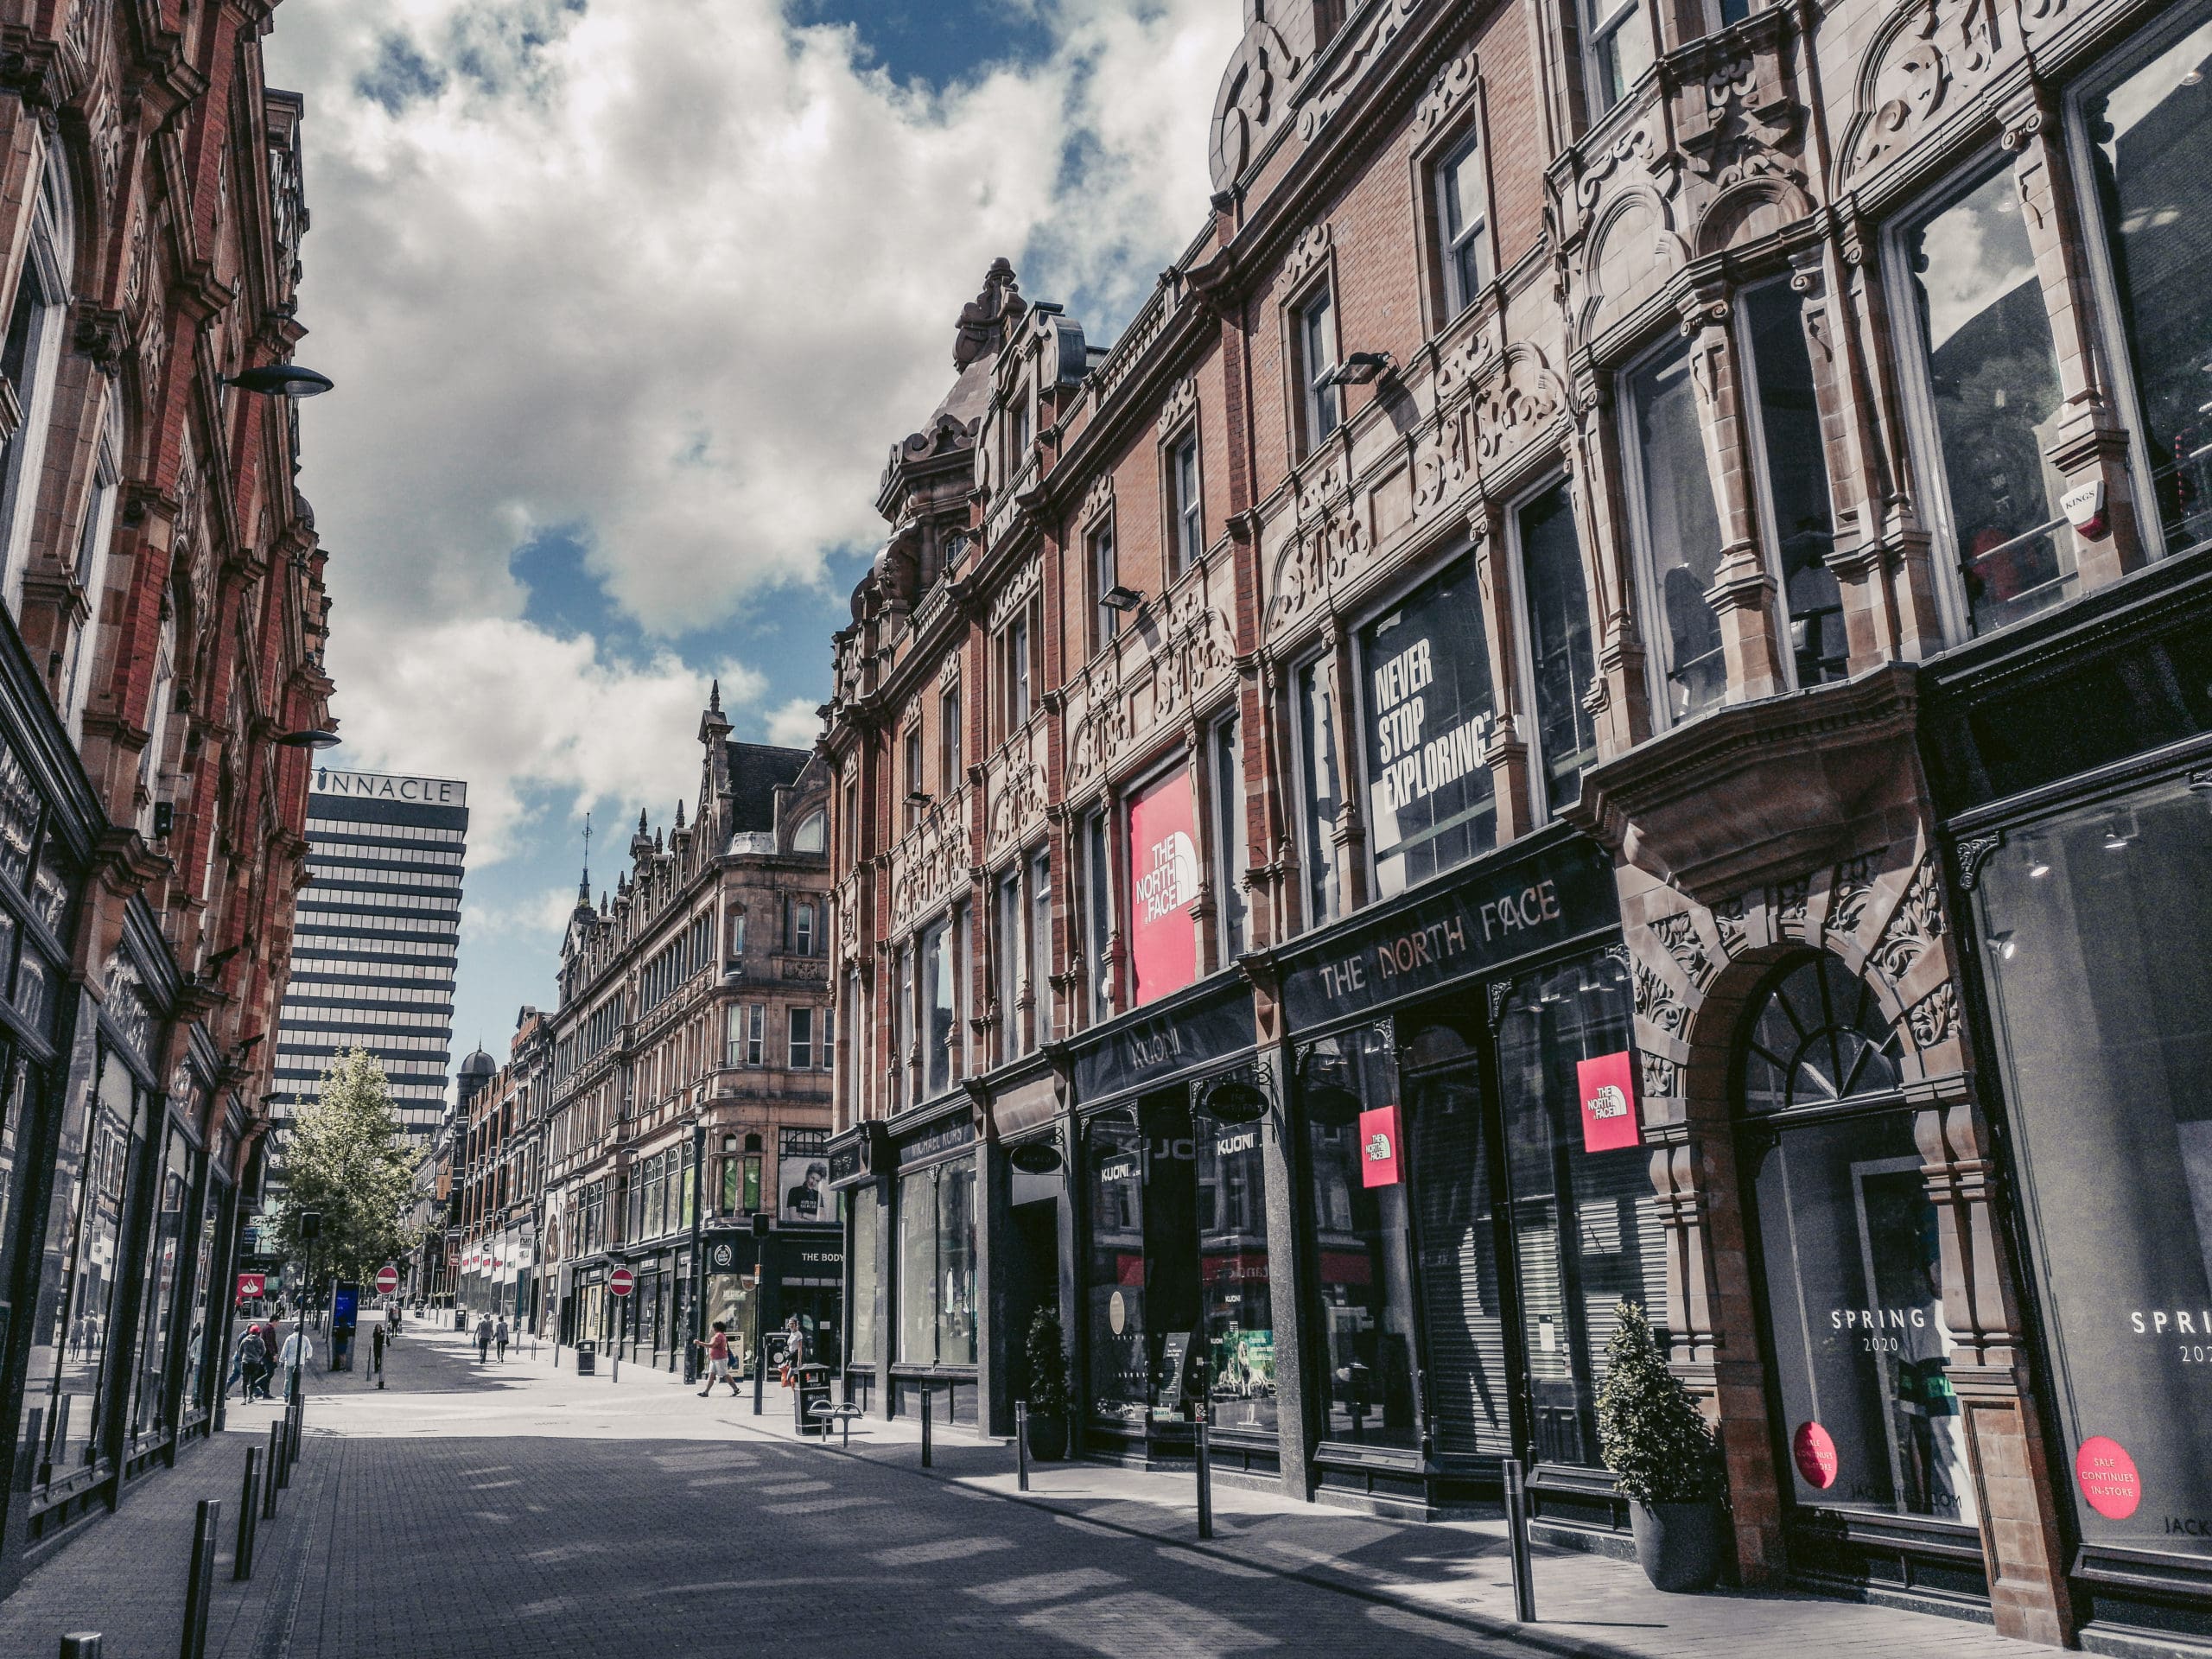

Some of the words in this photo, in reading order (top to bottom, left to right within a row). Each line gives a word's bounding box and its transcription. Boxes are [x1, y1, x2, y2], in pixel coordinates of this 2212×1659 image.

[2065, 490, 2095, 510] KINGS
[1374, 638, 1433, 715] NEVER
[1378, 695, 1425, 765] STOP
[308, 766, 452, 803] INNACLE
[1151, 833, 1176, 869] THE
[1135, 858, 1176, 906] NORTH
[1147, 882, 1177, 924] FACE
[1319, 954, 1367, 1000] THE
[1377, 915, 1467, 980] NORTH
[1479, 879, 1561, 942] FACE
[1130, 1027, 1181, 1071] KUONI
[1597, 1085, 1612, 1099] THE
[1587, 1096, 1614, 1112] NORTH
[1595, 1105, 1616, 1120] FACE
[911, 1137, 941, 1158] MICHAEL
[942, 1128, 963, 1148] KORS
[1217, 1133, 1255, 1156] KUONI
[1372, 1133, 1382, 1144] THE
[1365, 1142, 1383, 1155] NORTH
[1370, 1152, 1383, 1162] FACE
[1101, 1164, 1129, 1183] KUONI
[802, 1253, 819, 1262] THE
[821, 1253, 844, 1262] BODY
[1224, 1294, 1242, 1303] KUONI
[1831, 1308, 1926, 1330] SPRING
[2130, 1310, 2212, 1334] SPRI
[1863, 1337, 1898, 1352] 2020
[2094, 1457, 2116, 1468] SALE
[2082, 1471, 2135, 1484] CONTINUES
[2091, 1485, 2134, 1497] IN-STORE
